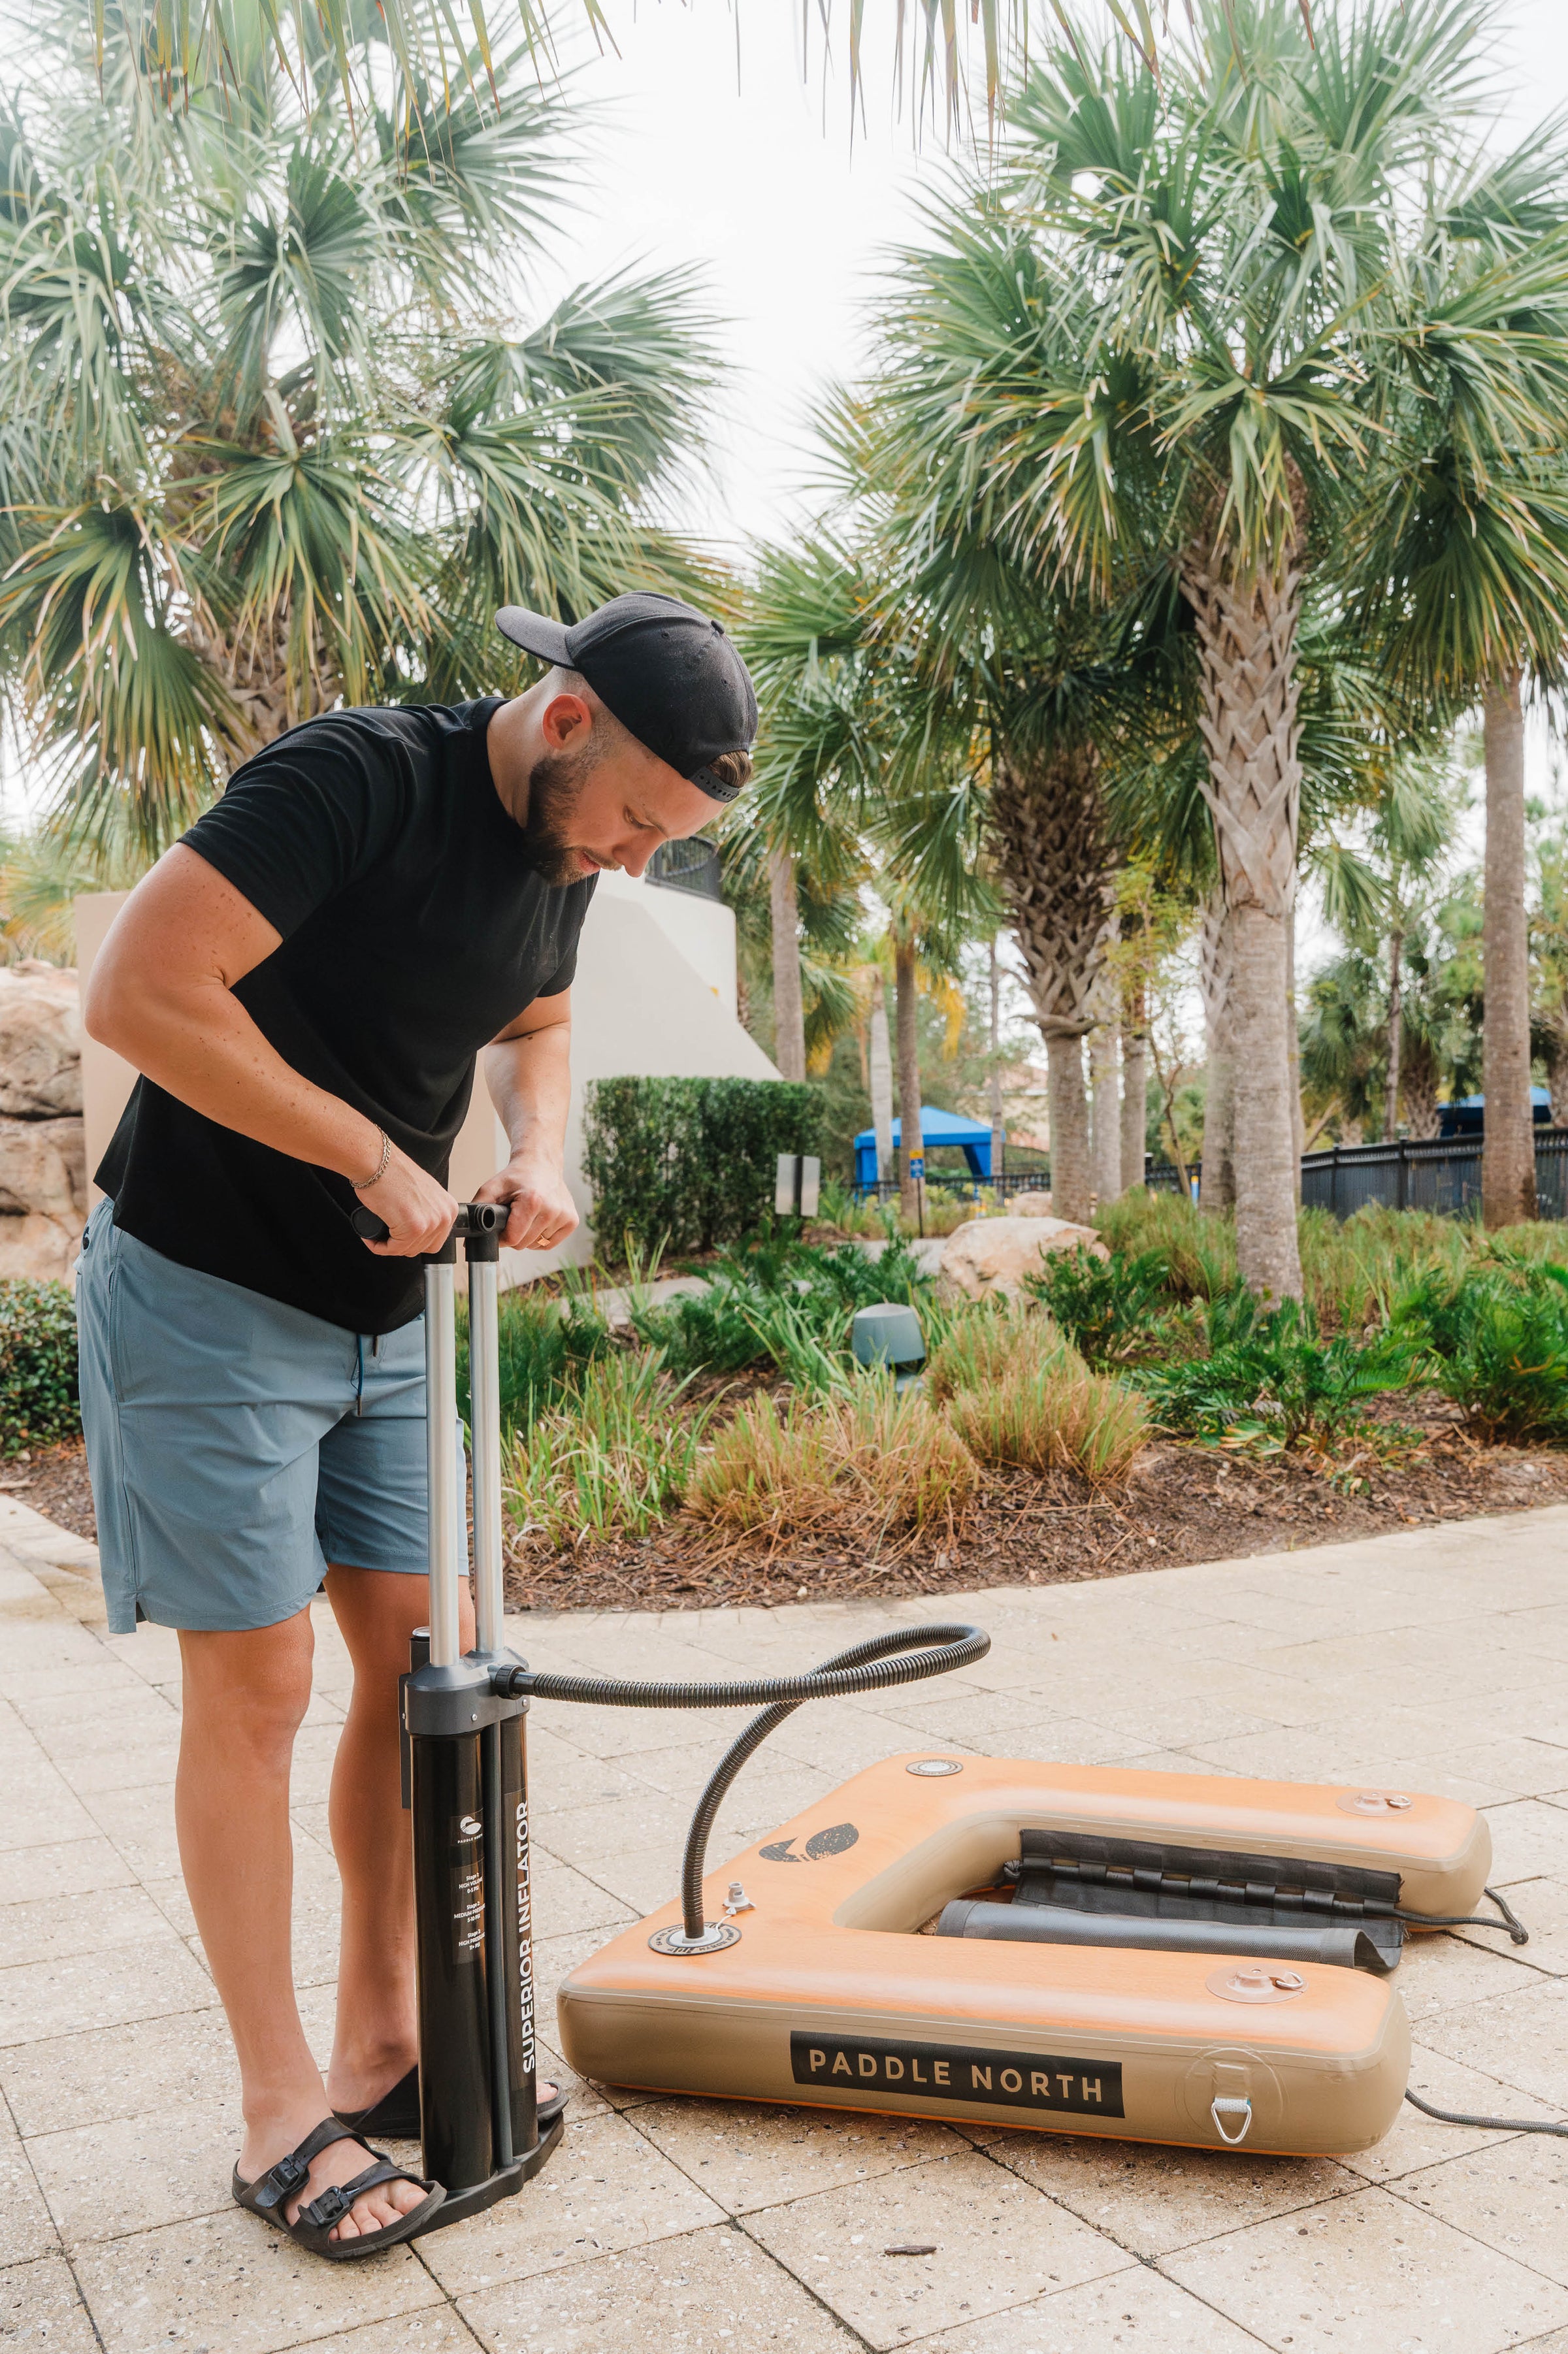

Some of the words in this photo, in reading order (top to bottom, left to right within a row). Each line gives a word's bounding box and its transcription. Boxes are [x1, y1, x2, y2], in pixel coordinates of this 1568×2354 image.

[516, 1800, 530, 1933] INFLATOR
[519, 1936, 535, 2074] SUPERIOR
[809, 2049, 951, 2085] PADDLE
[971, 2065, 1102, 2102] NORTH
